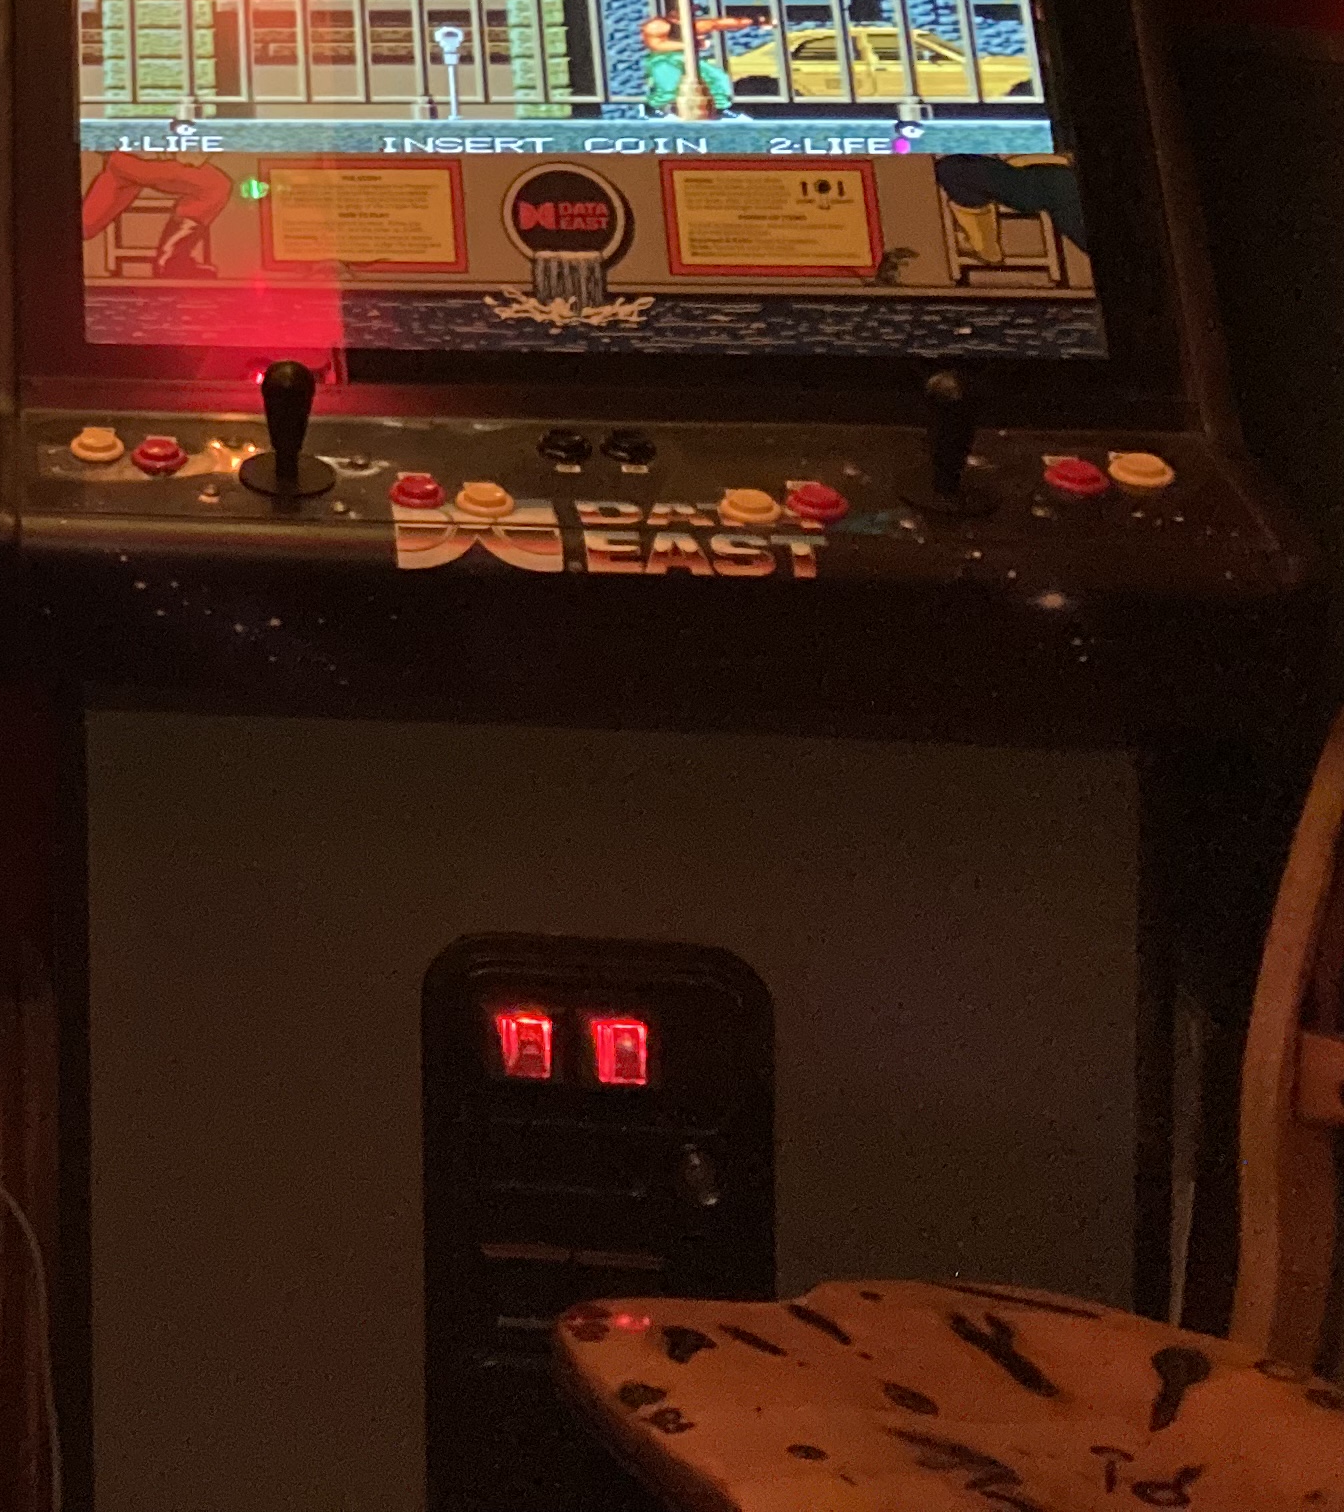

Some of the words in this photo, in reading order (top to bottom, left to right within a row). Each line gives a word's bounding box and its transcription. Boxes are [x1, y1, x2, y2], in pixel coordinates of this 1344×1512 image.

[382, 137, 554, 154] INSERT
[584, 137, 709, 154] COIN
[583, 530, 827, 577] EAST
